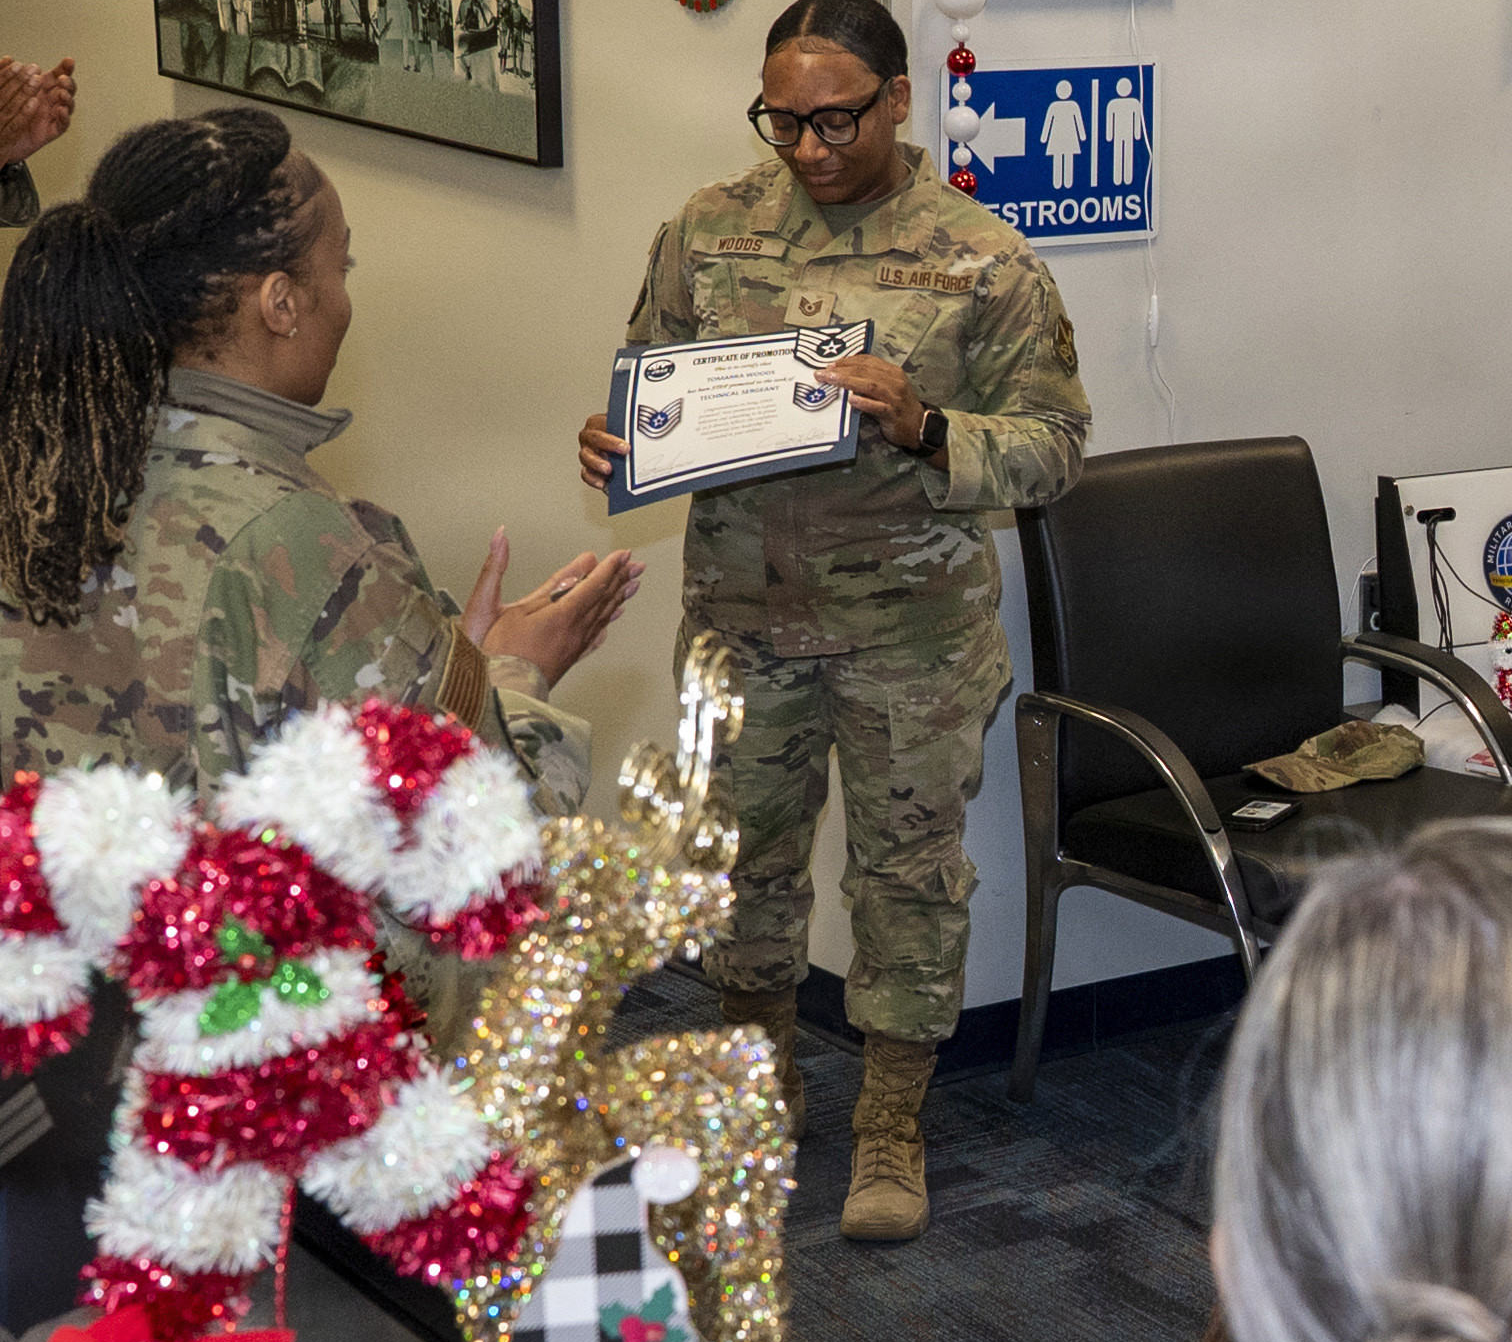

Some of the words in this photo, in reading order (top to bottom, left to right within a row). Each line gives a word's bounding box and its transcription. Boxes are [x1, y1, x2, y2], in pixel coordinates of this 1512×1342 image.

[984, 194, 1141, 227] STROOMS
[717, 236, 763, 252] WOODS
[879, 266, 905, 286] U.S.
[908, 270, 931, 288] AIR
[933, 272, 974, 292] FORCE
[692, 354, 738, 365] CERTIFICATE
[740, 352, 749, 360] OF
[751, 347, 796, 359] PROMOTION
[700, 390, 739, 402] TECHNICAL
[741, 385, 780, 396] SERGEANT
